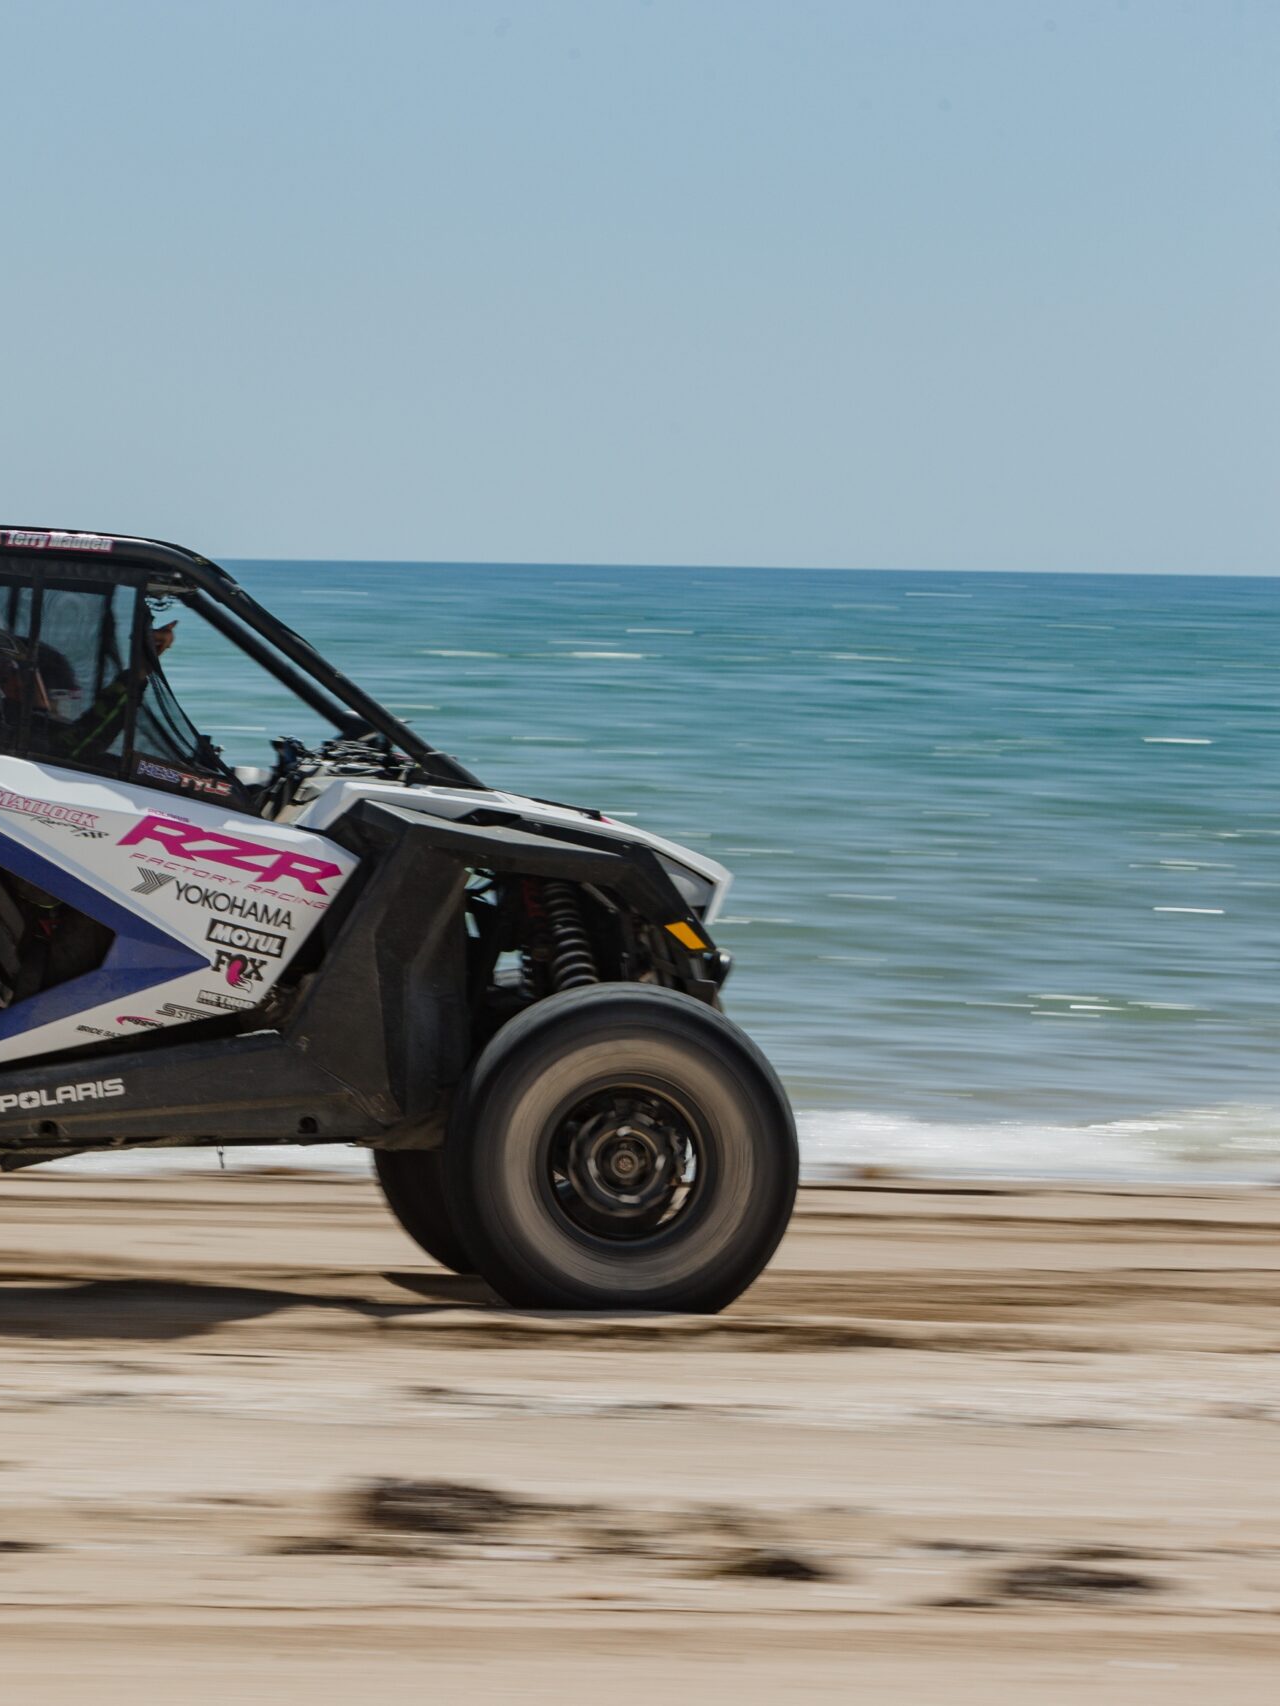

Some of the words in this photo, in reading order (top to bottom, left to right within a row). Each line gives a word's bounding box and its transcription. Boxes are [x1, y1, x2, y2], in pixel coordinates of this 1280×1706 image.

[115, 815, 344, 897] RZR
[128, 852, 240, 885] FACTORY
[243, 882, 331, 910] RACING
[174, 879, 294, 930] YOKOHAMA
[208, 921, 283, 956] MOTUL
[211, 949, 268, 986] FOX
